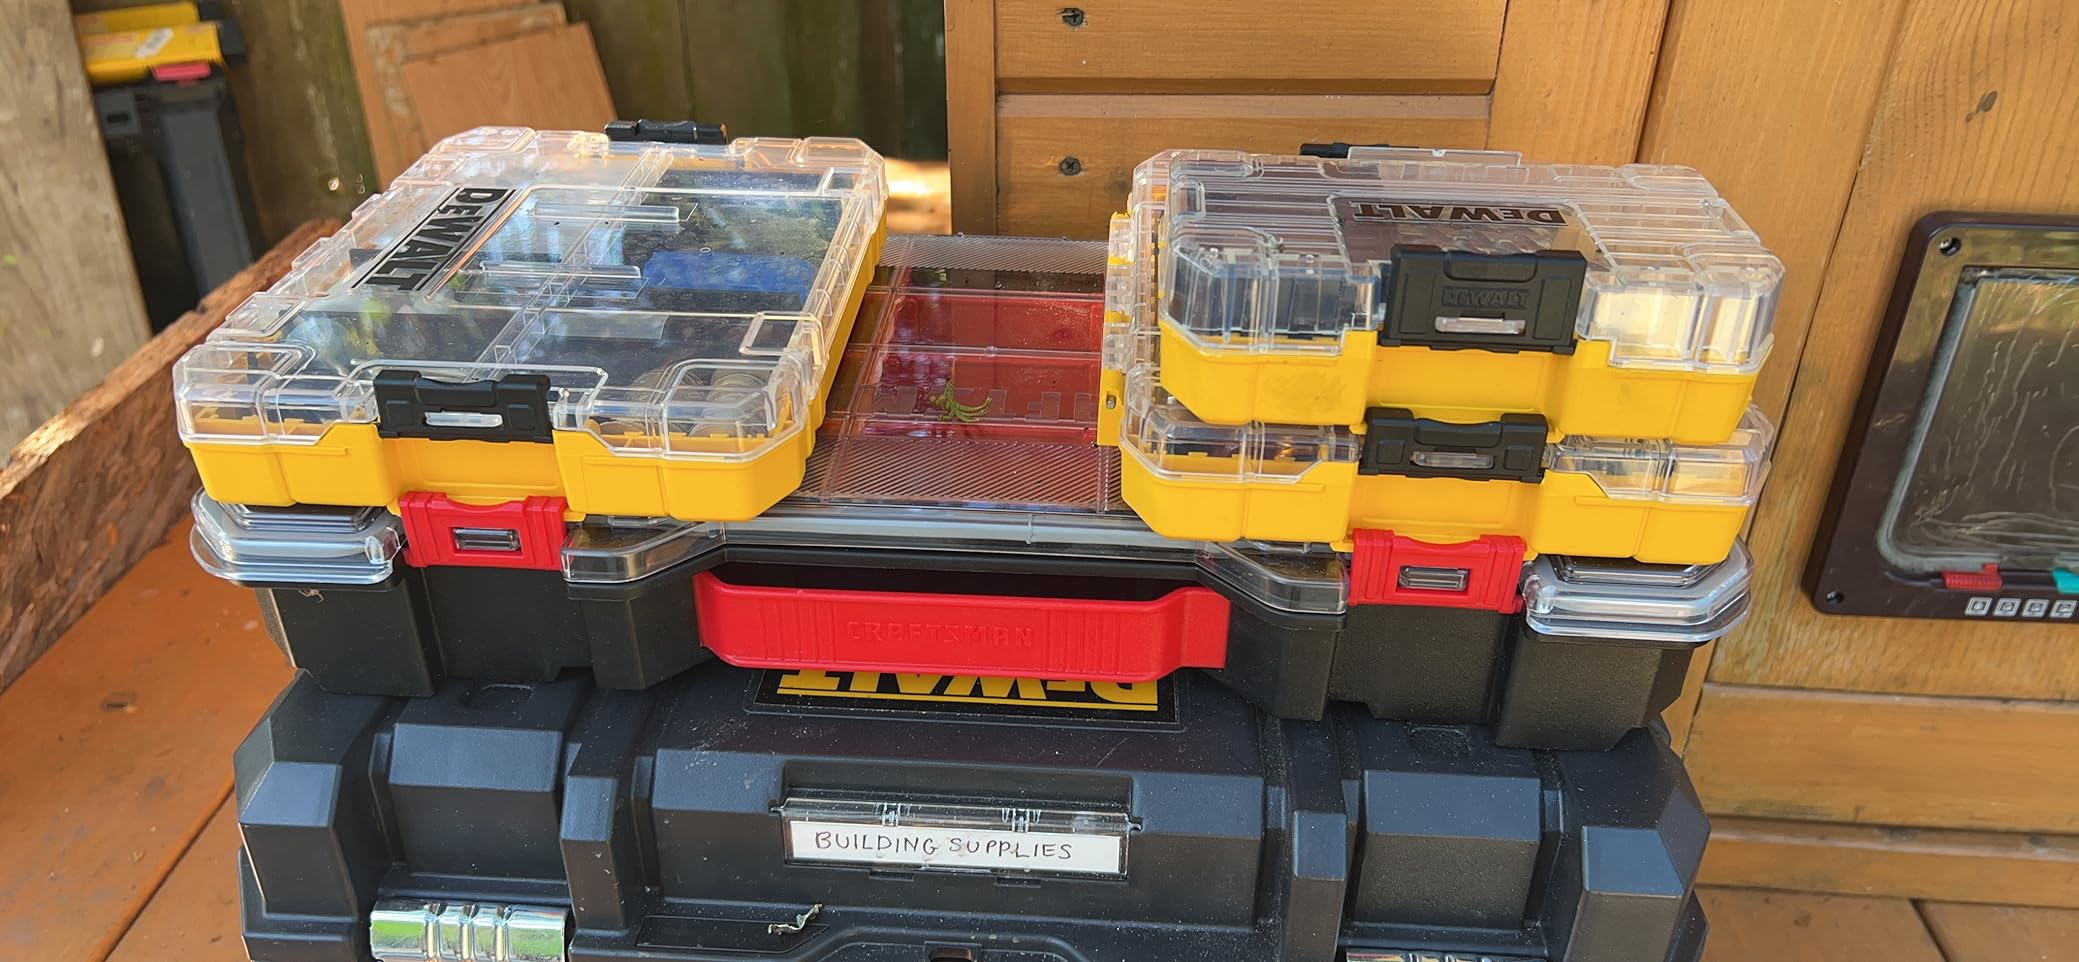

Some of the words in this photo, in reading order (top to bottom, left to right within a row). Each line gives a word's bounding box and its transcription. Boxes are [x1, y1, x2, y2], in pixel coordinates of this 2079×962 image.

[1353, 203, 1567, 225] DEWALT
[364, 187, 511, 291] DEWALT
[848, 621, 1033, 647] CRAFTSMAN
[814, 831, 938, 855] BUILDING
[949, 837, 1072, 859] SUPPLIES
